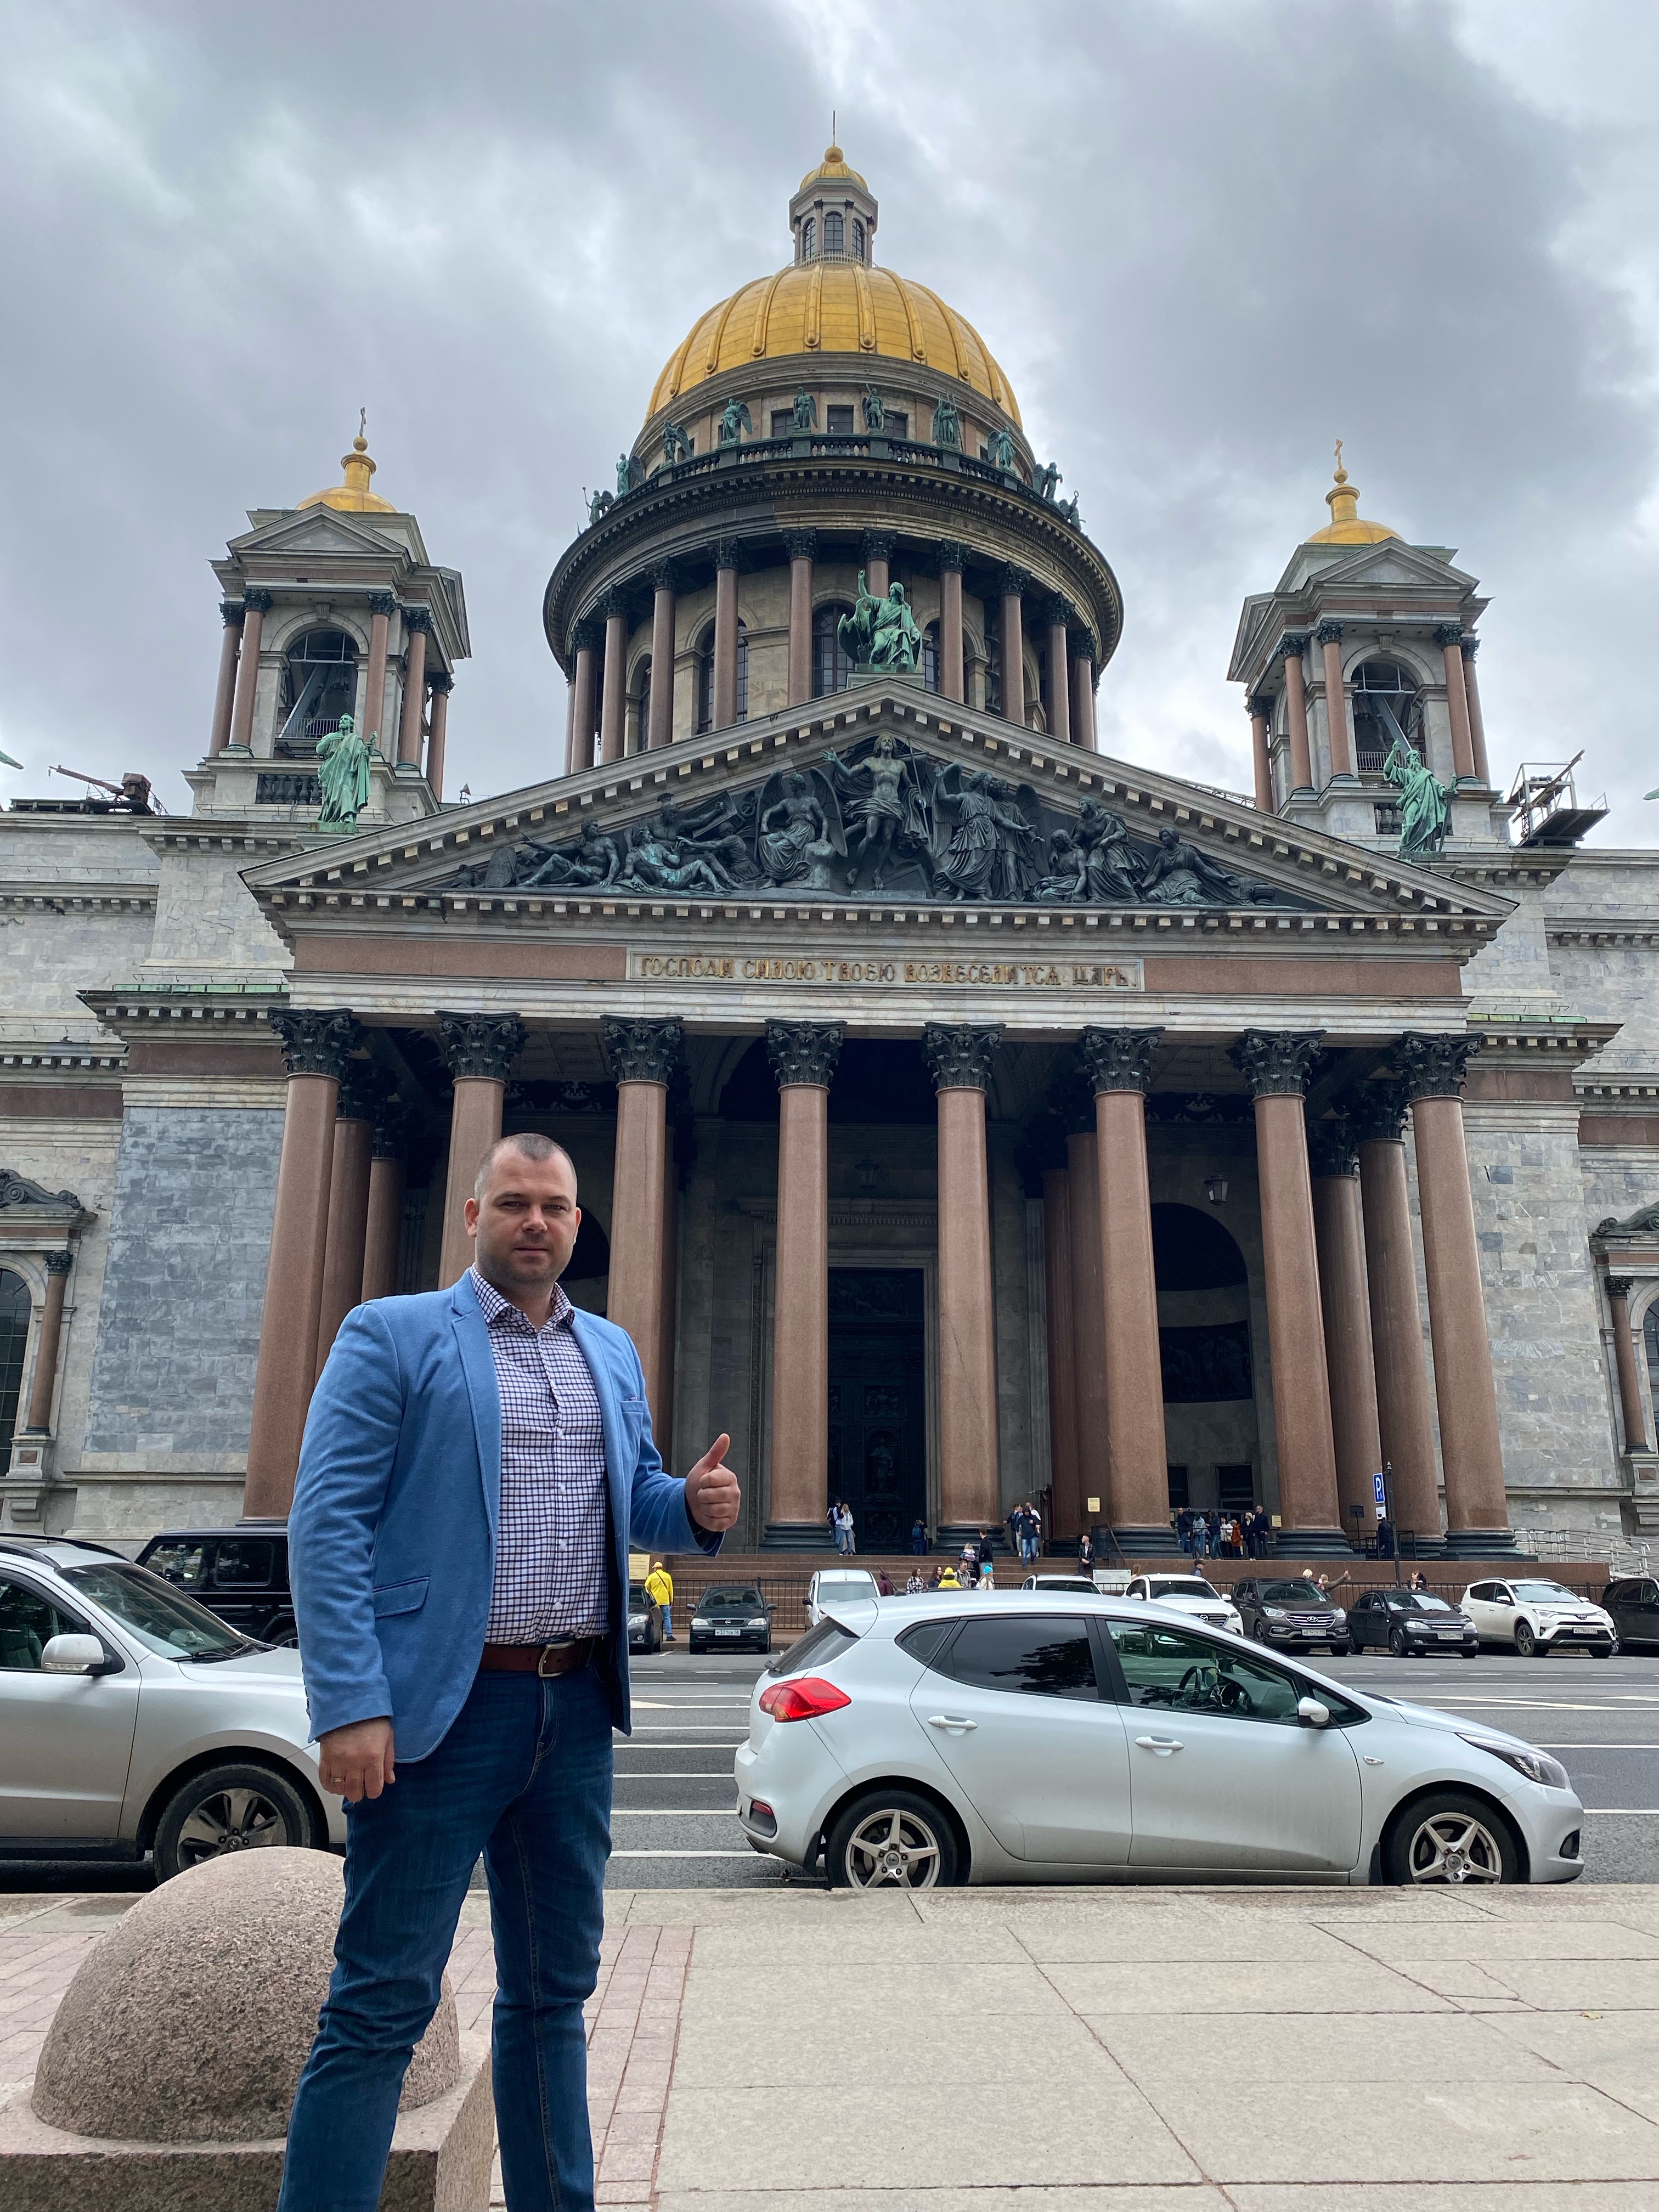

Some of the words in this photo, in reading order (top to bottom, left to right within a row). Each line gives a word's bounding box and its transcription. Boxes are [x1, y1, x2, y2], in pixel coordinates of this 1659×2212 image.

[641, 958, 733, 978] ГОСПОДИ
[742, 959, 816, 980] СИЛОЮ
[822, 961, 896, 981] ТВОЕЮ
[1375, 1477, 1381, 1500] P
